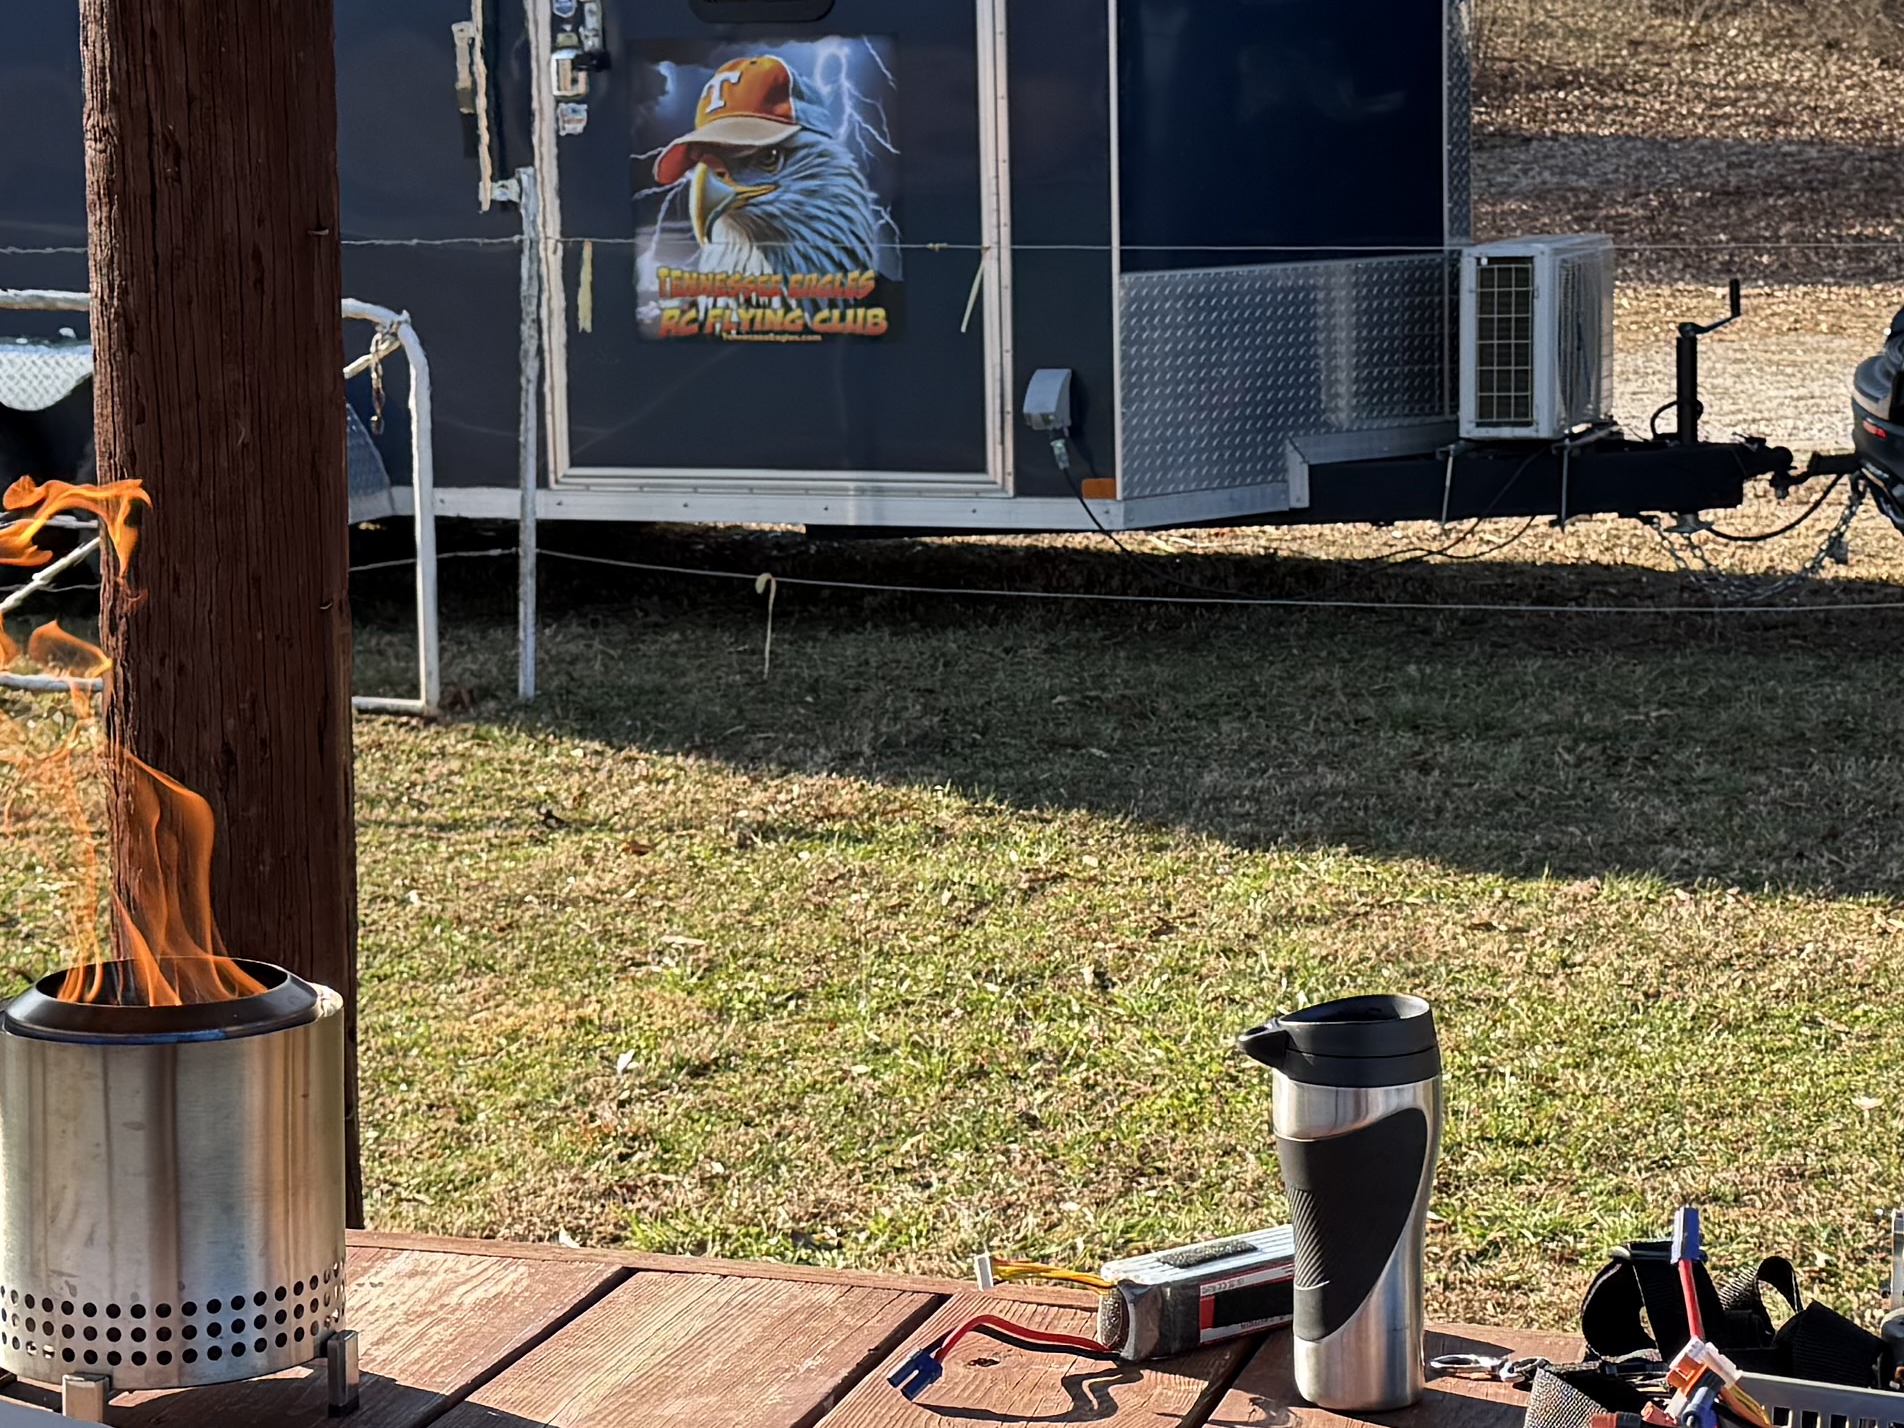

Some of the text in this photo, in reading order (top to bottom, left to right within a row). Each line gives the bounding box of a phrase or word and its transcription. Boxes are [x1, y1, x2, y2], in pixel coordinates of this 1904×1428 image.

[657, 267, 876, 299] TENNESSEE EAGLES
[658, 306, 889, 338] RC FLYING CLUB
